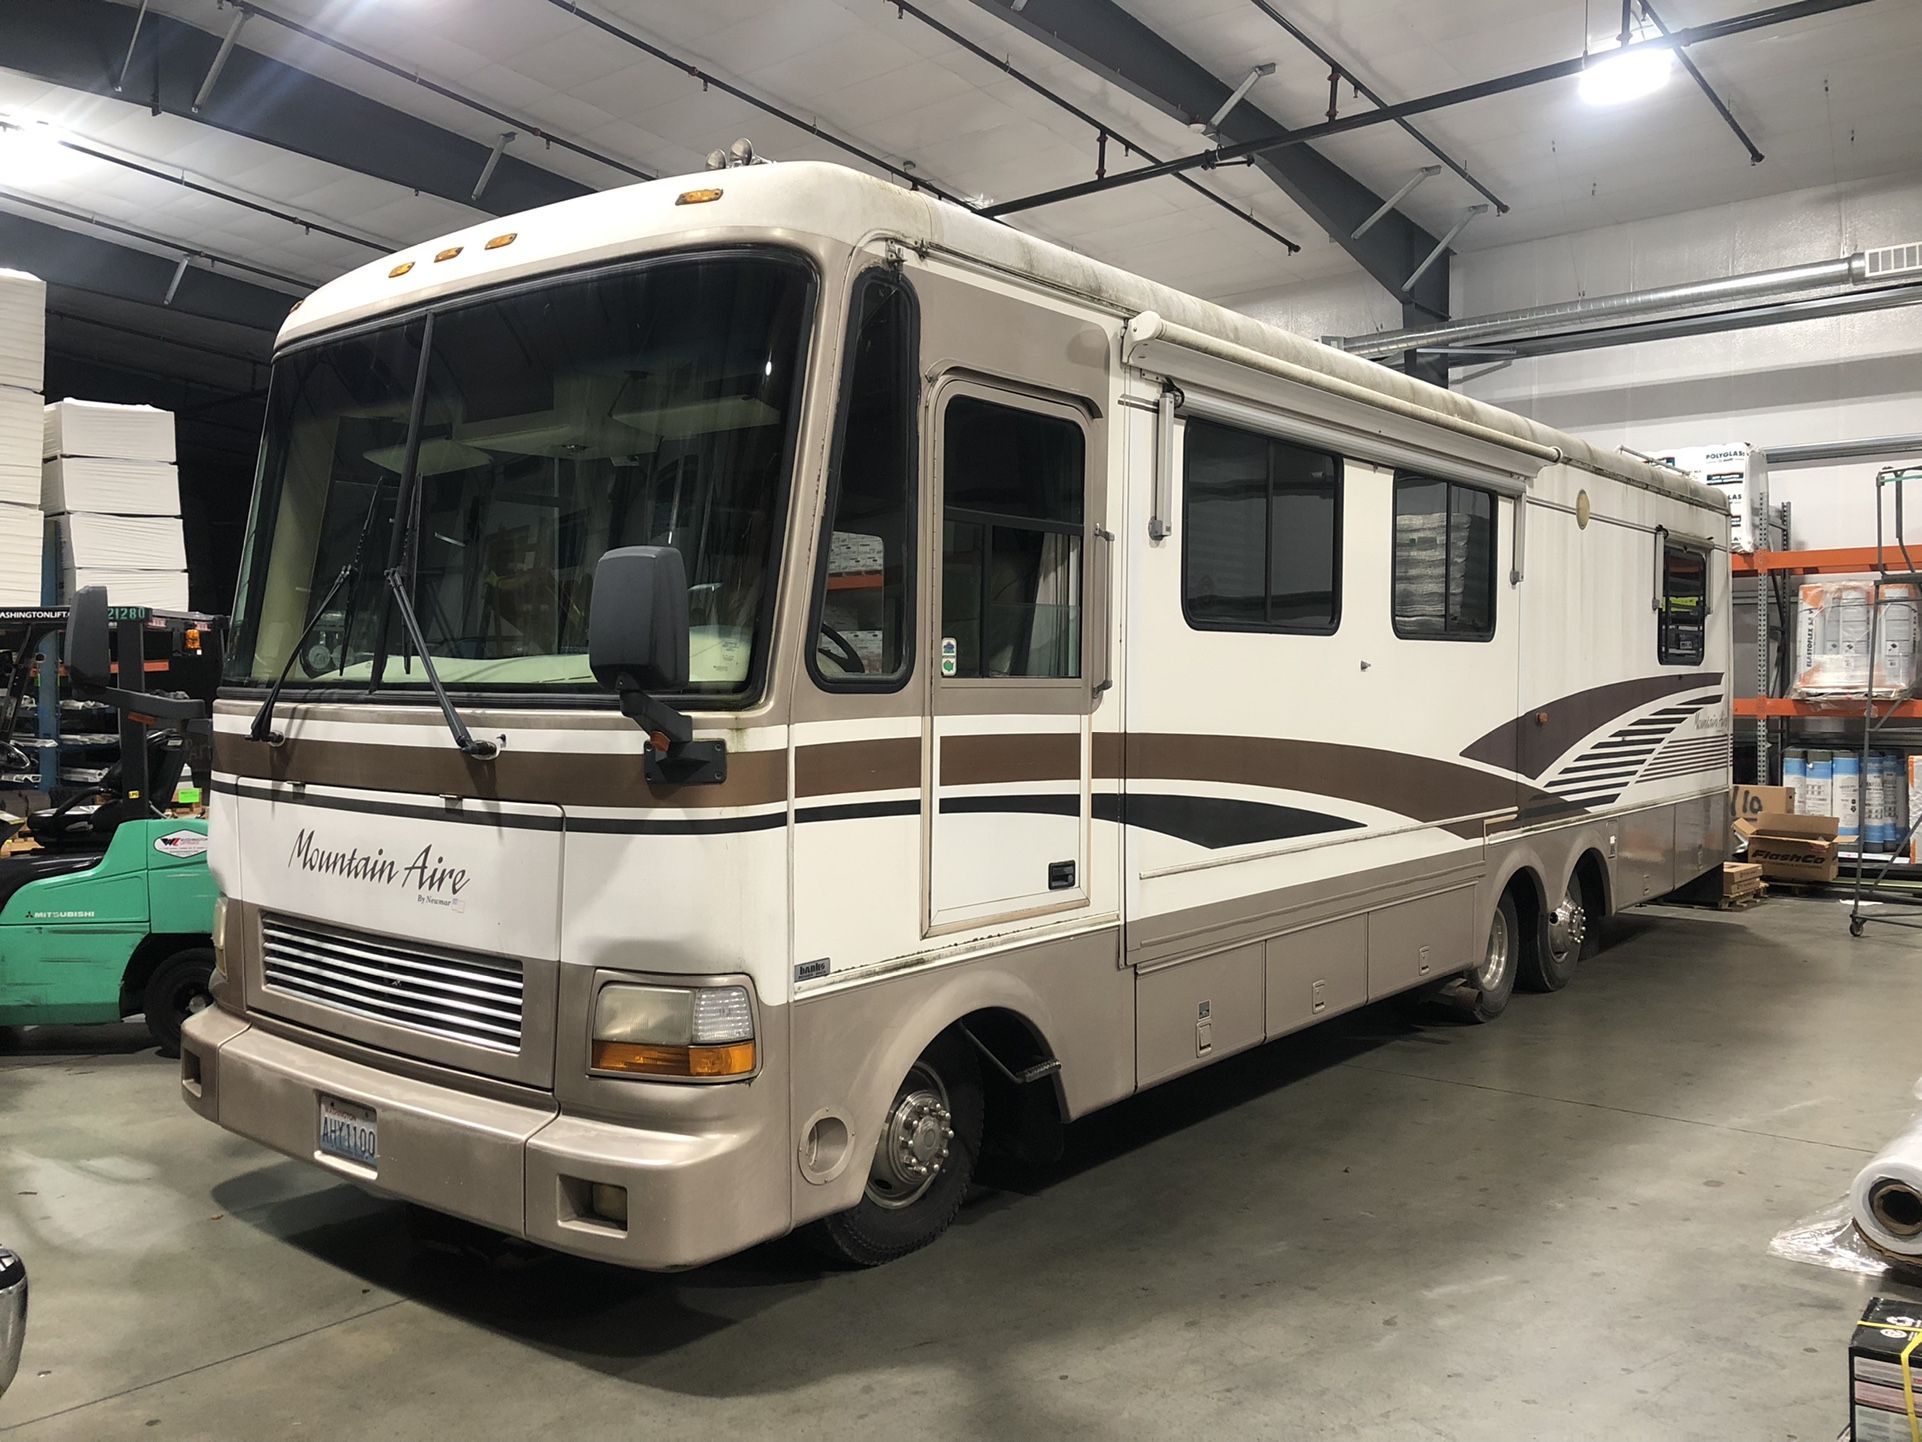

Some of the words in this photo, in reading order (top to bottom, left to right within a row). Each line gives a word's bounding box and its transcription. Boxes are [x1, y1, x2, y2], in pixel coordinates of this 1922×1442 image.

[0, 611, 71, 619] ASHINGTONLIFT.
[108, 607, 145, 620] 21280
[288, 828, 399, 885] Mountain
[401, 843, 471, 896] Aire
[1751, 849, 1826, 864] FlashCo
[417, 894, 426, 905] By
[426, 896, 452, 906] Newmar
[322, 1116, 375, 1156] AHY1100
